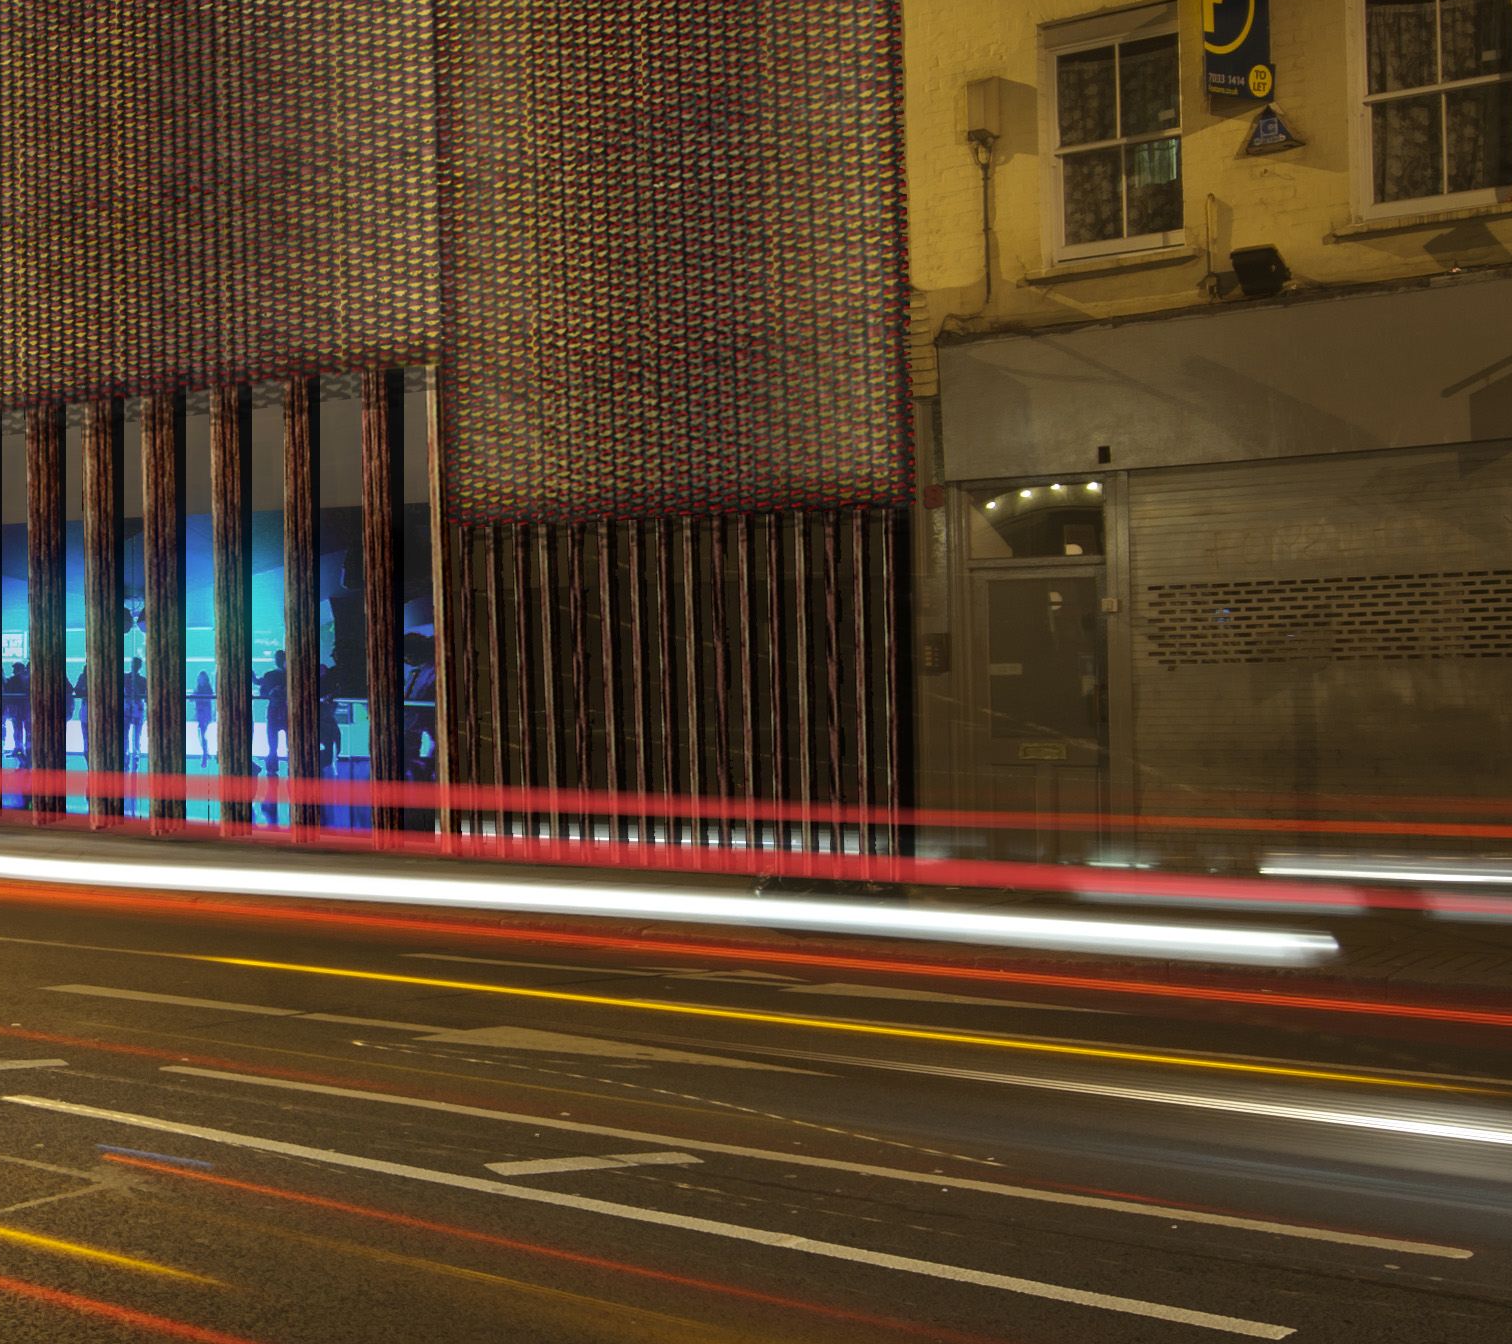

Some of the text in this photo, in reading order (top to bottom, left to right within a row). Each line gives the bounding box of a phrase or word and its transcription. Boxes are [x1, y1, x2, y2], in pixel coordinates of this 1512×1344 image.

[1254, 69, 1267, 80] TO
[1228, 75, 1246, 86] 1414
[1253, 82, 1267, 92] LET
